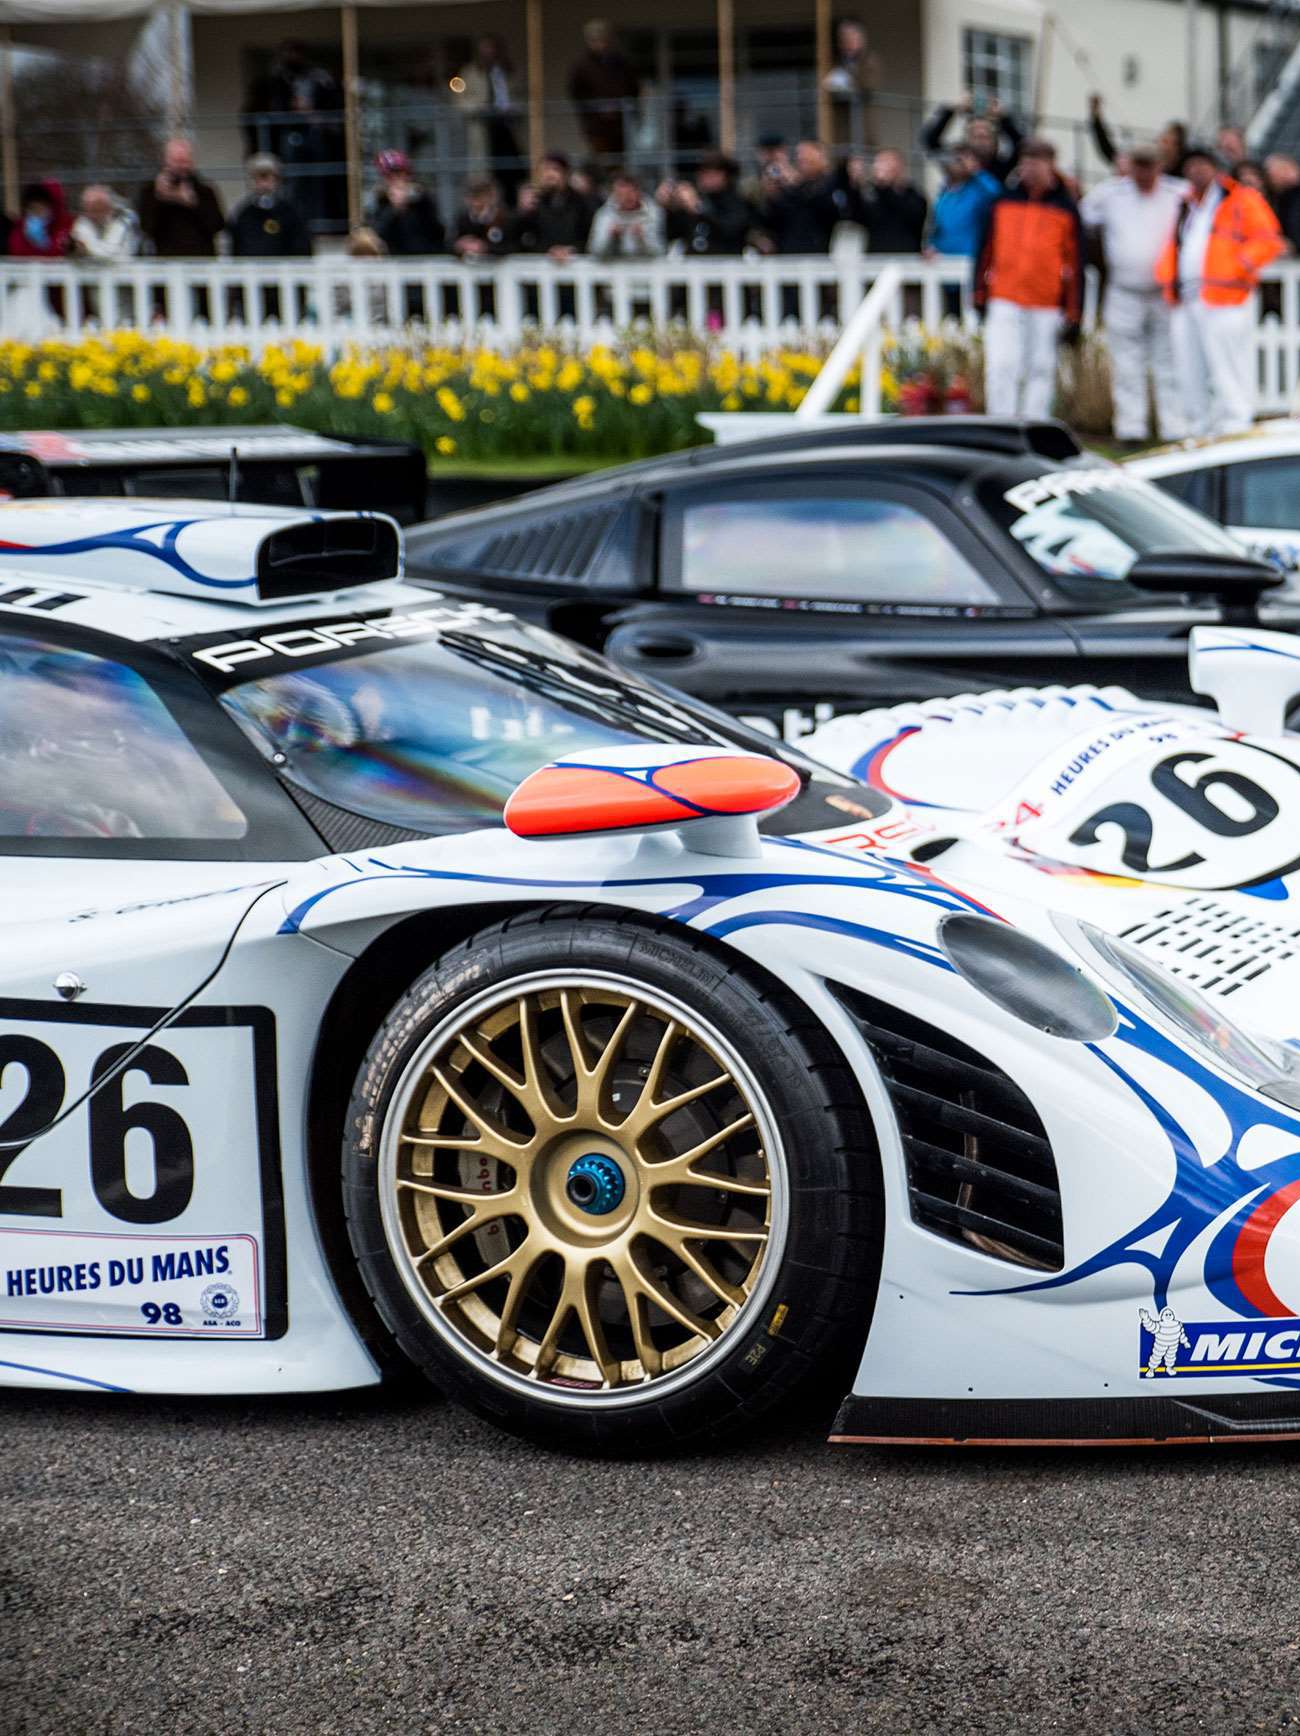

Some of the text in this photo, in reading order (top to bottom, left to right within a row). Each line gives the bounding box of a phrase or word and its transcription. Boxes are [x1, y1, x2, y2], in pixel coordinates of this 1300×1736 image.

[1050, 739, 1109, 796] HEURES
[1068, 752, 1280, 872] 26
[0, 1034, 195, 1225] 26
[7, 1245, 230, 1297] HEURES DU MANS
[140, 1301, 183, 1326] 98
